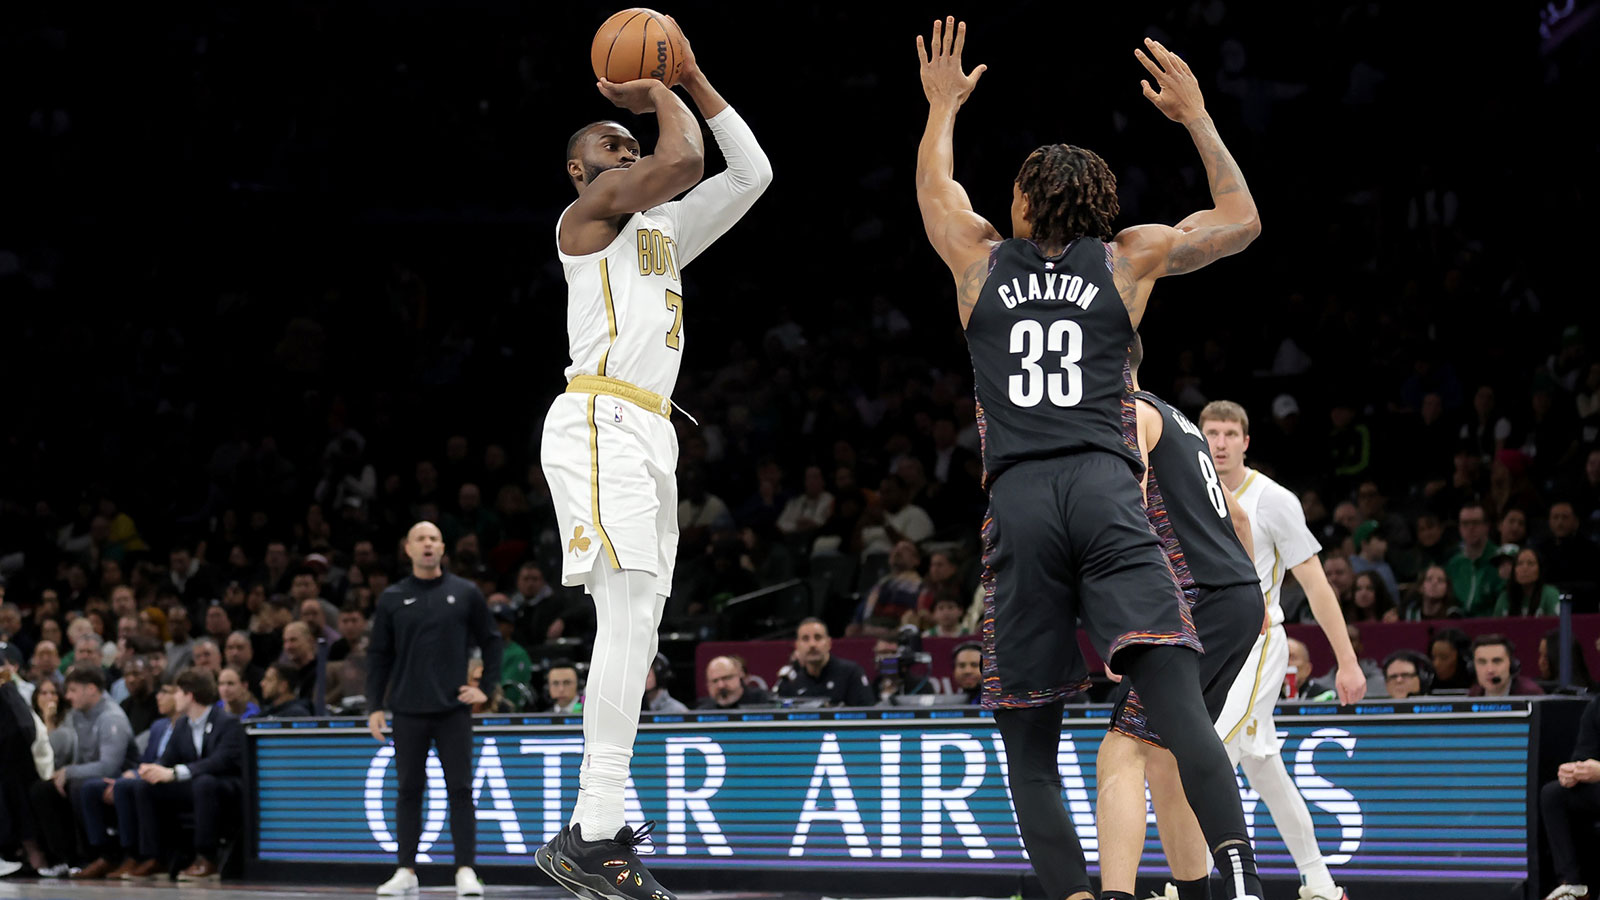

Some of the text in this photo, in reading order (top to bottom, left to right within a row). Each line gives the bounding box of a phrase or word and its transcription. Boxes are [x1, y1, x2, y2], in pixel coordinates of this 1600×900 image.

[651, 40, 668, 81] lson
[665, 288, 683, 351] 7
[997, 272, 1100, 311] CLAXTON
[1008, 319, 1084, 408] 33
[1198, 450, 1228, 519] 8
[788, 728, 1363, 866] AIRS
